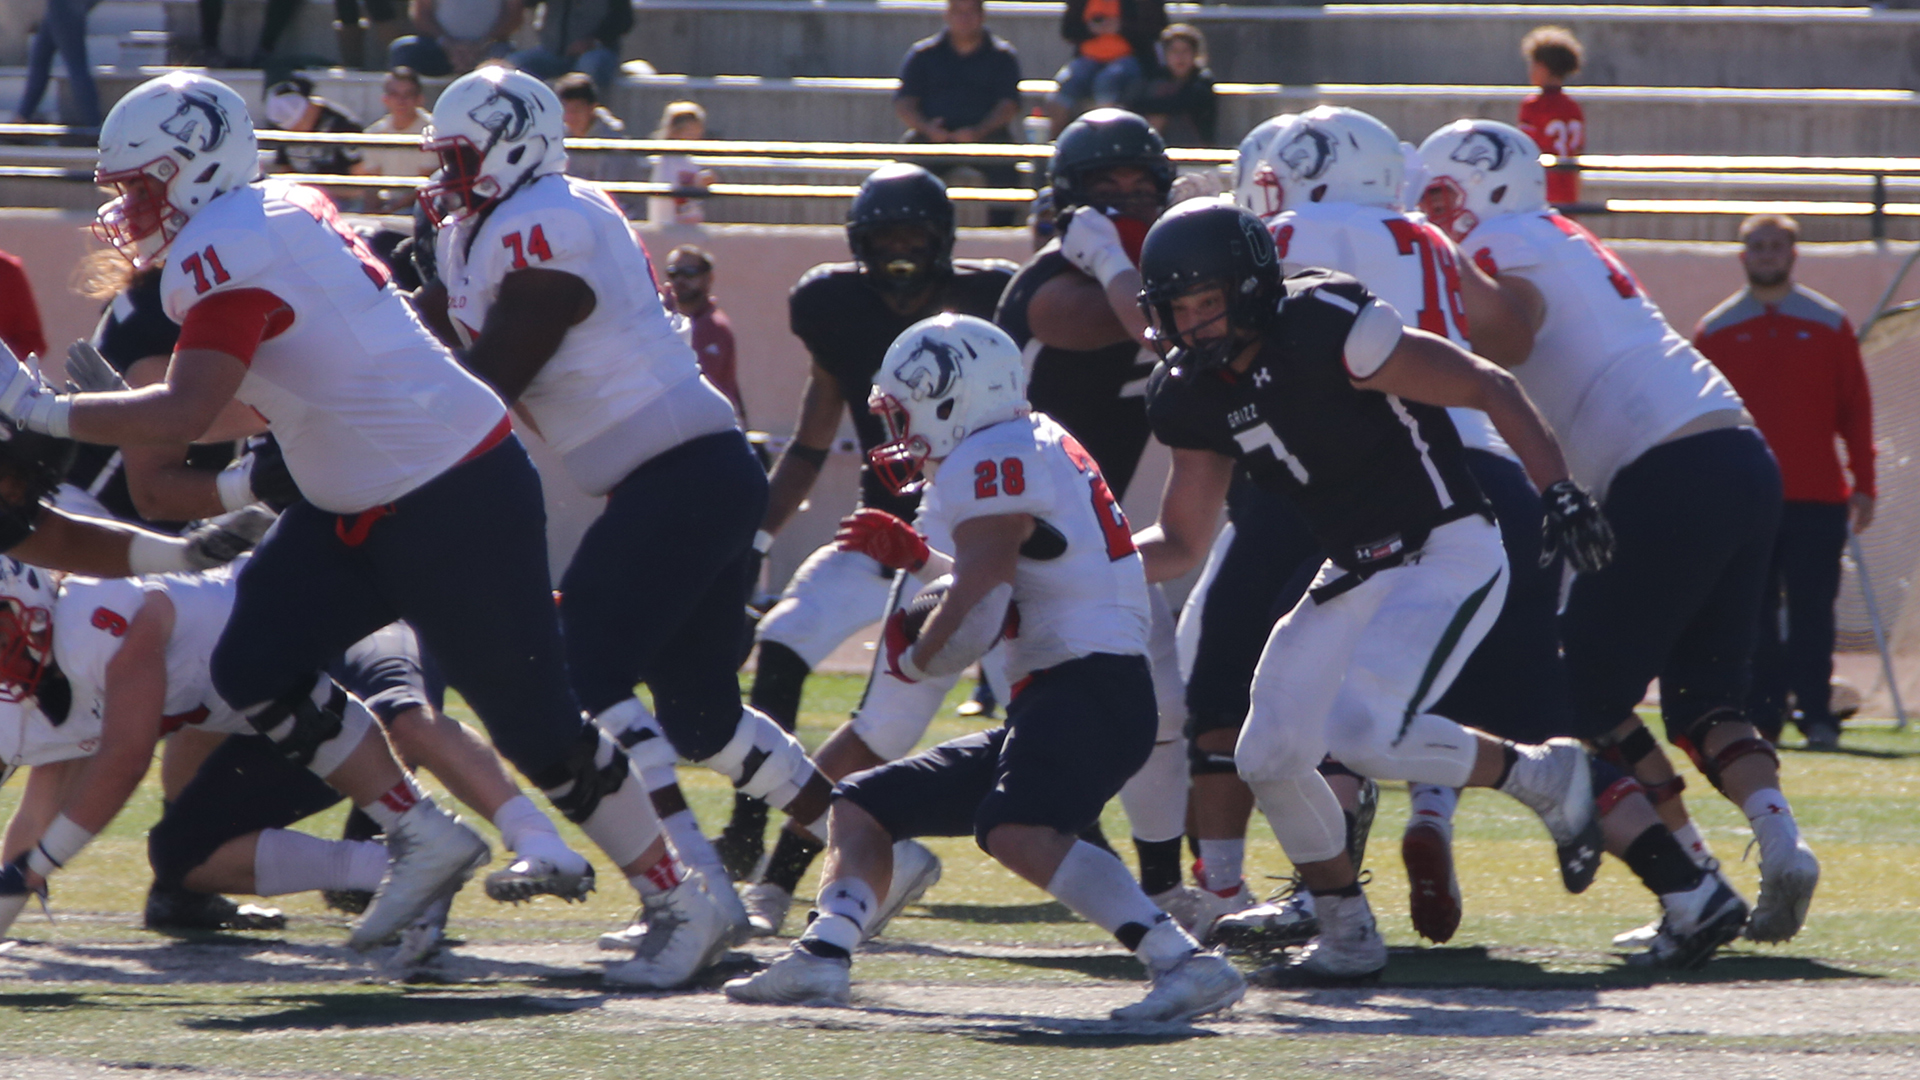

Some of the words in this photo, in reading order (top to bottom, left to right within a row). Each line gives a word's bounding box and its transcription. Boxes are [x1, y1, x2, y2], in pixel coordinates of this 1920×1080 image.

[502, 223, 553, 269] 74
[181, 245, 231, 295] 71
[1227, 403, 1258, 428] GRIZZ
[1232, 421, 1310, 485] 7
[974, 457, 1026, 499] 28
[90, 605, 128, 638] 9
